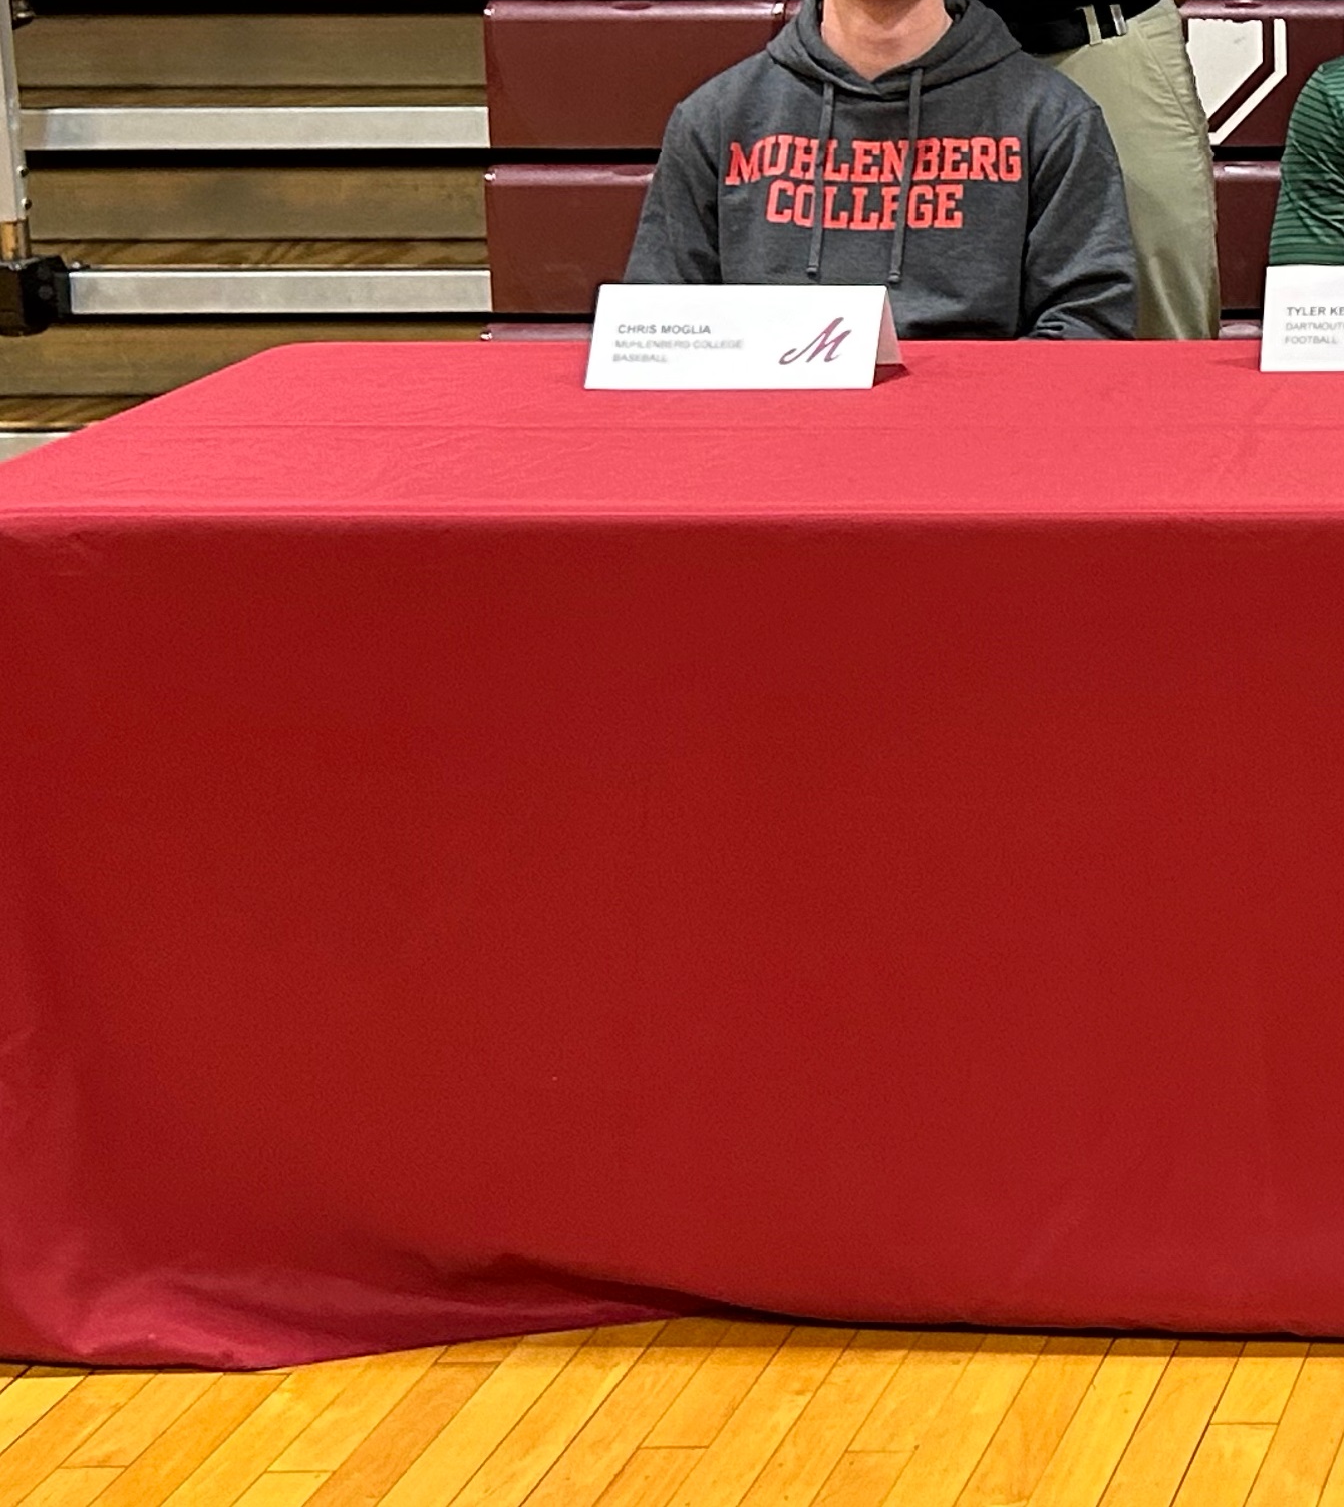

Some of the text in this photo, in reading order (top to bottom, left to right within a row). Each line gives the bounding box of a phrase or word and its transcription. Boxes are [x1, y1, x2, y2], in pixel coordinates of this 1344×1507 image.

[725, 134, 1022, 185] MUHLENBERG
[766, 179, 964, 230] COLLEGE
[1287, 306, 1327, 316] TYLER
[618, 324, 711, 334] CHRIS MOGLIA
[1285, 335, 1338, 344] FOOTBALL
